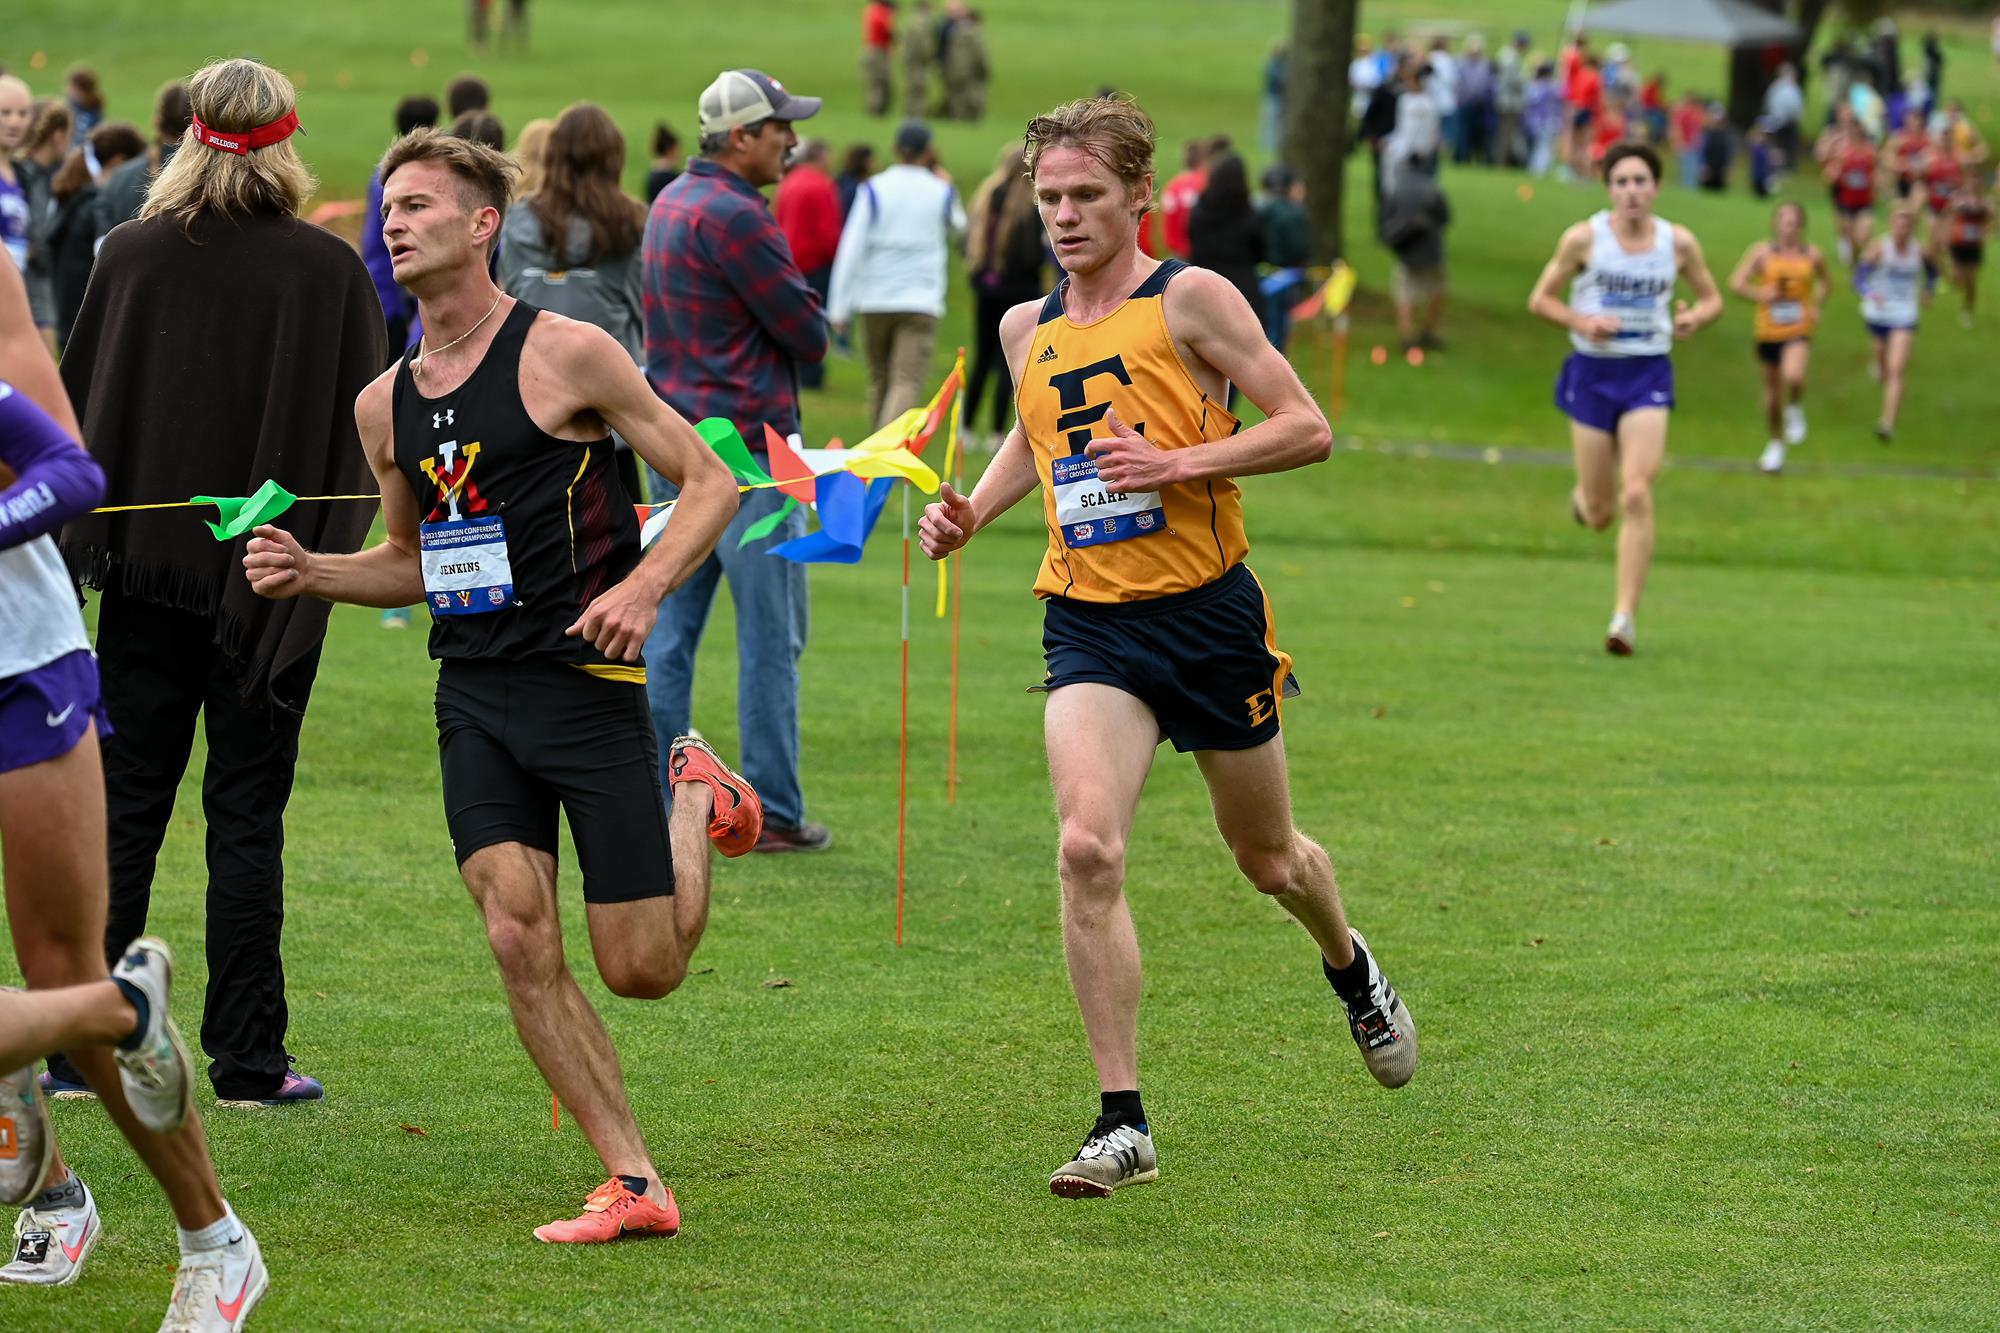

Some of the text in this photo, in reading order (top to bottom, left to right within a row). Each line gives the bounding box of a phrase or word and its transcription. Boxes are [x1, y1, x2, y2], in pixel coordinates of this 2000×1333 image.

[209, 136, 239, 150] BULLDOGS
[1037, 353, 1058, 364] adidas
[1068, 463, 1080, 471] 2021
[1069, 470, 1085, 479] CROSS
[425, 523, 501, 540] 2021 SOUTHERN CONFERENCE
[440, 536, 461, 545] COUNTRY
[461, 531, 503, 543] CHAMPIONSHIPS
[440, 561, 480, 575] JENKINS
[1244, 687, 1274, 728] E
